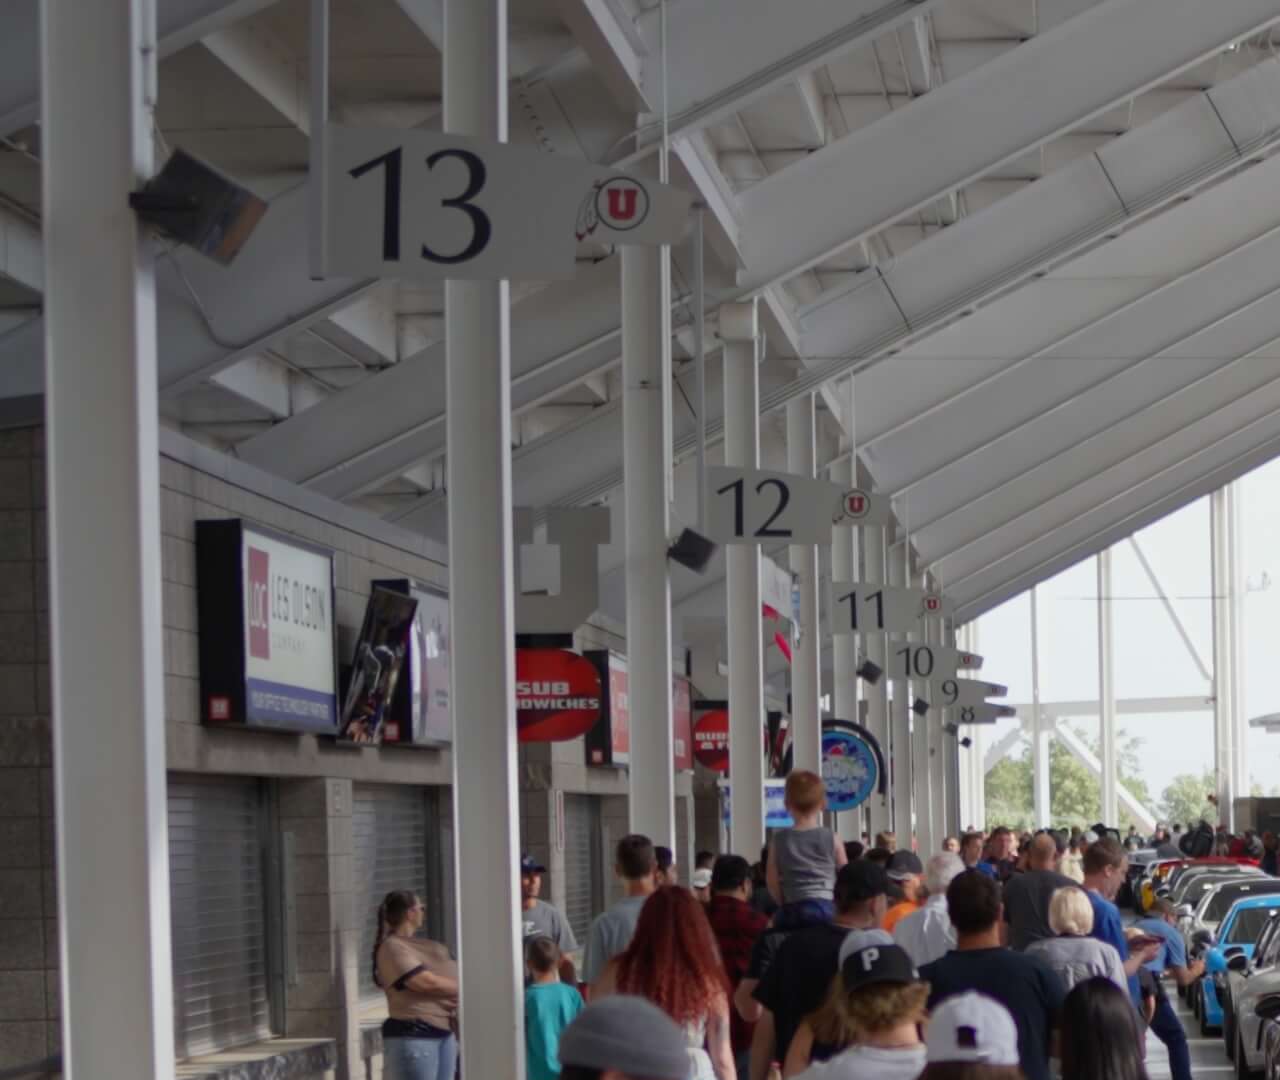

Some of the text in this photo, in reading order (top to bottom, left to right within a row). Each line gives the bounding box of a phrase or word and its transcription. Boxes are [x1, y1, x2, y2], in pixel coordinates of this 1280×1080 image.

[347, 146, 494, 265] 13
[716, 477, 792, 538] 12
[837, 589, 884, 630] 11
[896, 646, 934, 677] 10
[516, 682, 570, 695] SUB
[941, 679, 959, 705] 9
[516, 698, 600, 710] DWICHES
[862, 947, 880, 972] P
